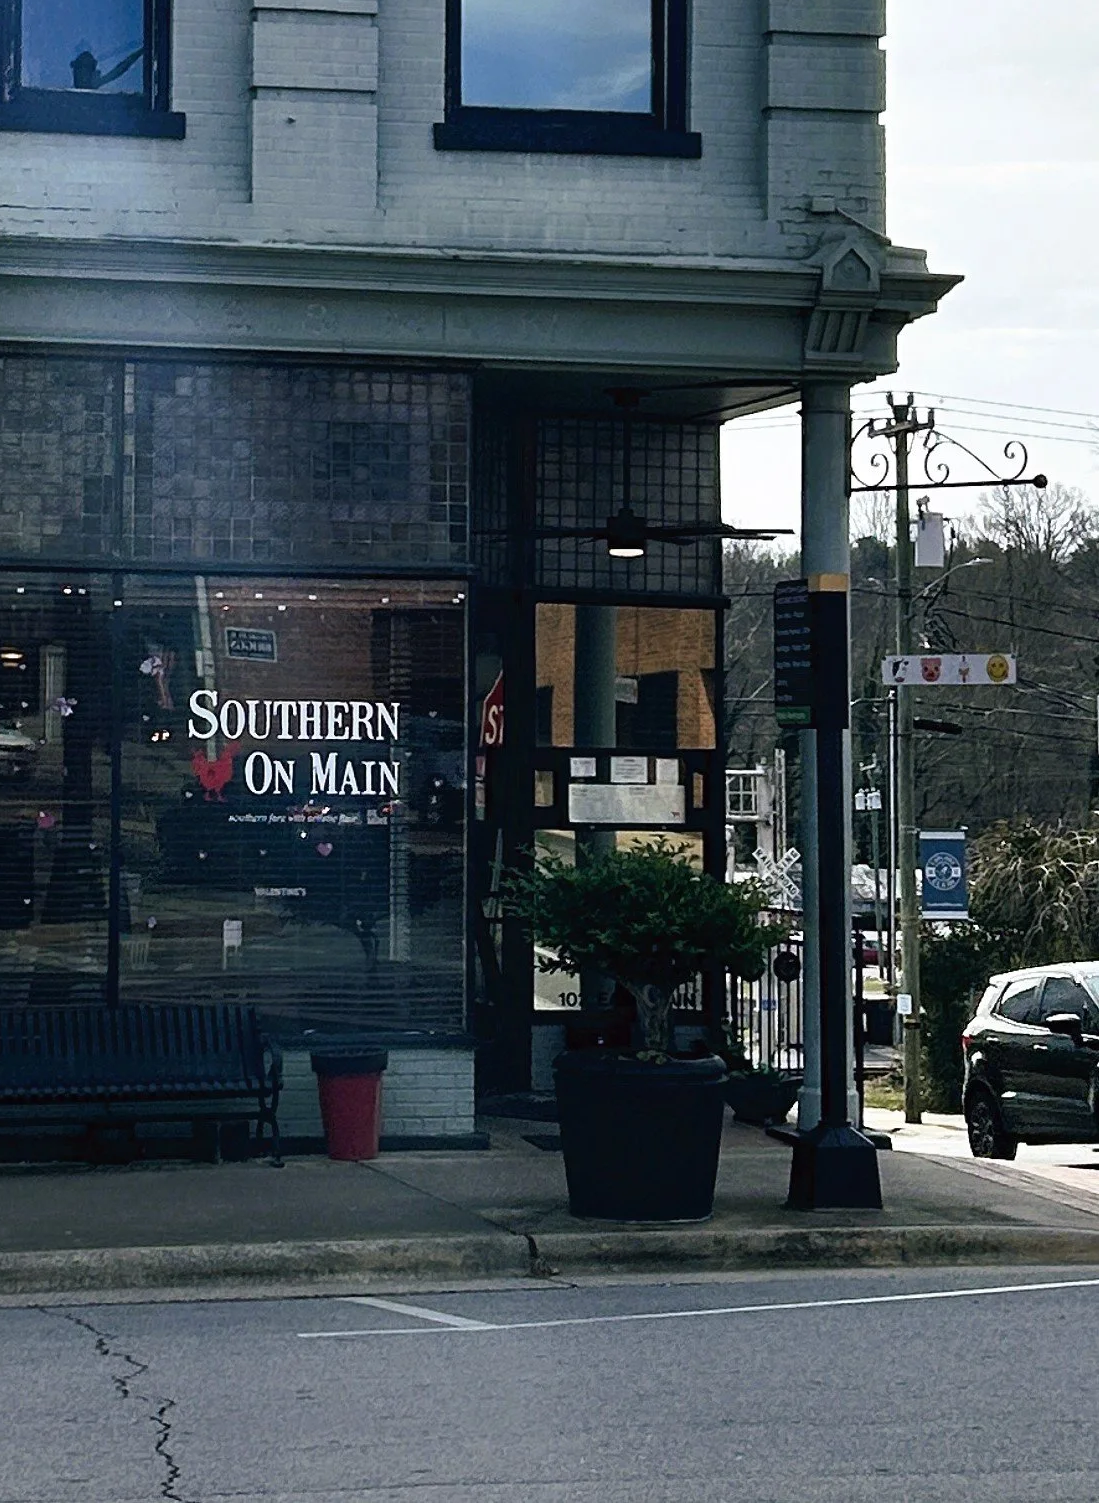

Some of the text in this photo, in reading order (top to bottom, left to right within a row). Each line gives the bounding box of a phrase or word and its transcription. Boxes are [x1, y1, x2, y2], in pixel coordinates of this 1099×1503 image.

[187, 689, 401, 741] SOUTHERN
[244, 751, 401, 796] ON MAIN
